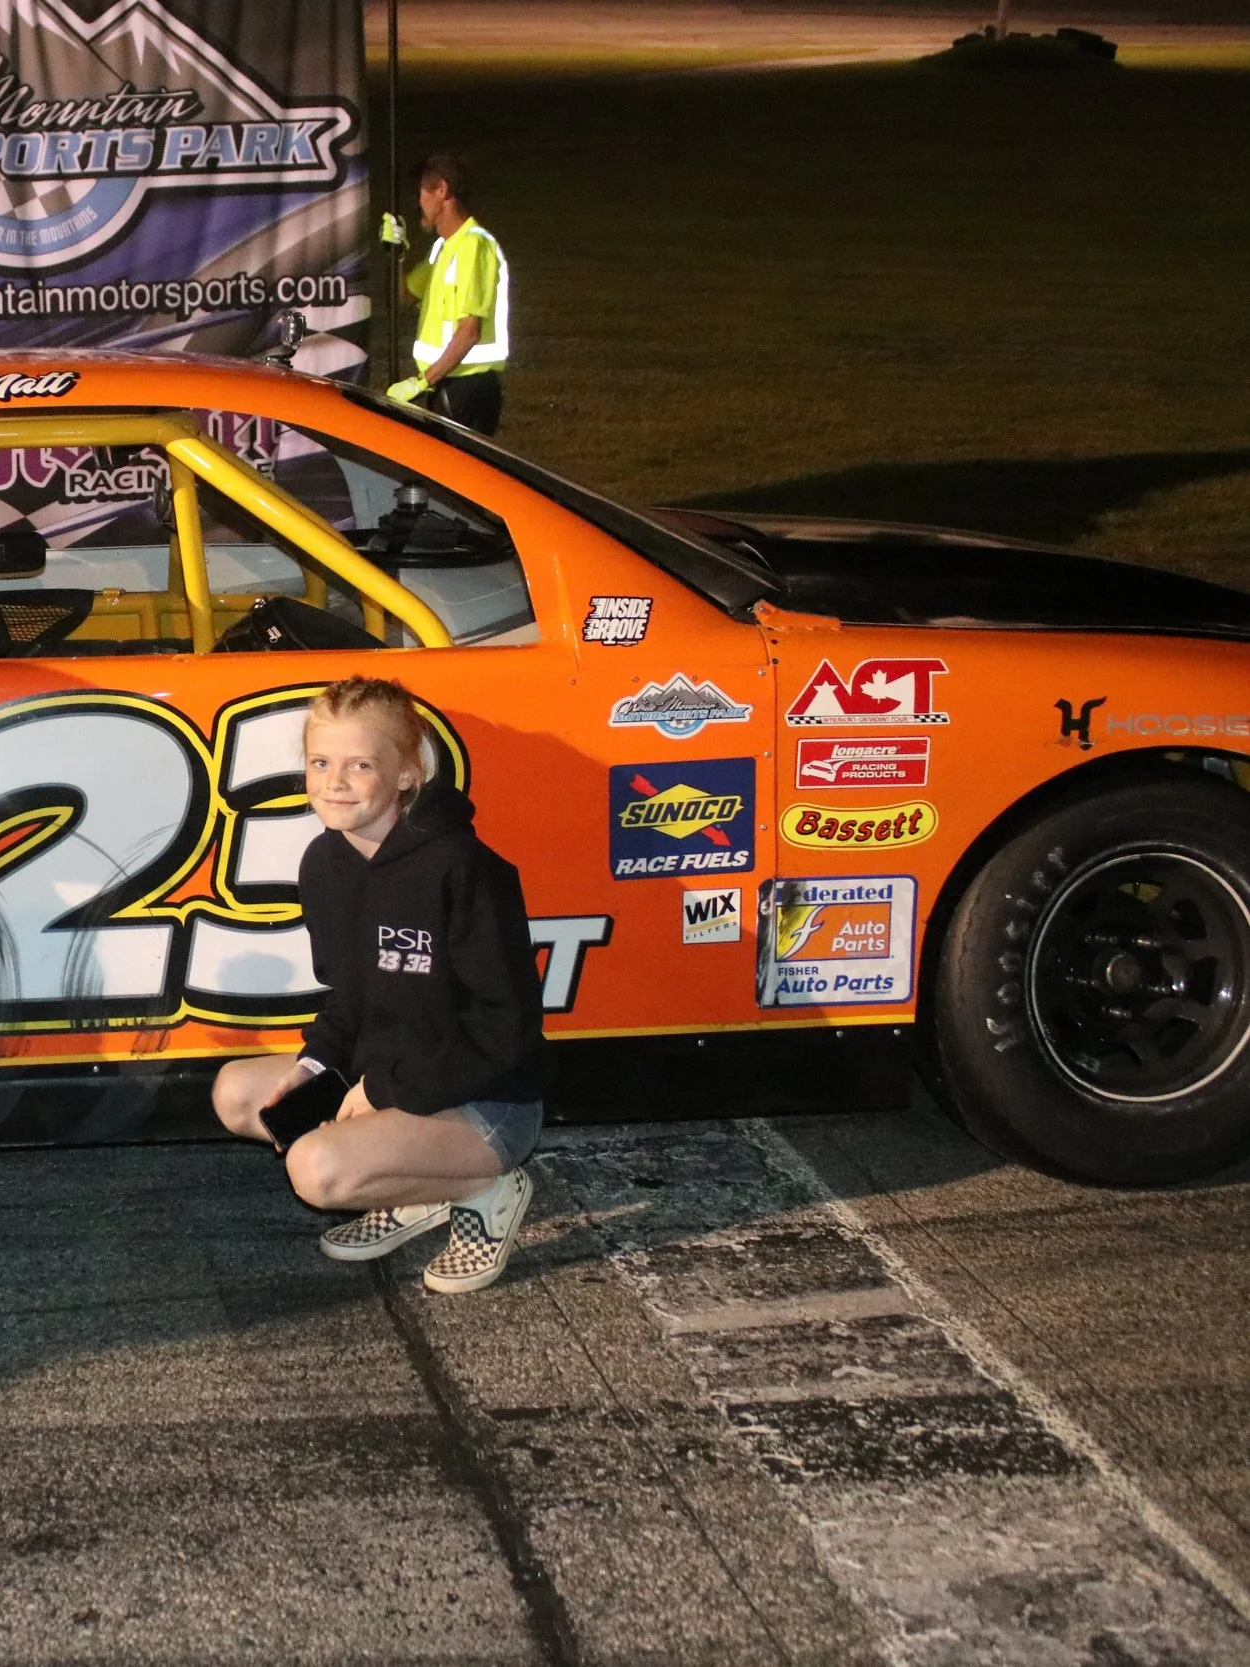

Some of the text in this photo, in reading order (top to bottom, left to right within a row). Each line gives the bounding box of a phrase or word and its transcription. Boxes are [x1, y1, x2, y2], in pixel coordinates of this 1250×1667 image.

[162, 120, 320, 168] PARK
[5, 229, 17, 245] IN
[20, 230, 38, 246] THE
[39, 205, 99, 243] MOUNTAINS
[69, 465, 172, 497] RACIN
[709, 707, 750, 719] PARK
[841, 771, 906, 779] PRODUCTS
[852, 763, 897, 772] RACING
[624, 797, 738, 825] SUNOCO
[795, 807, 923, 842] Bassett
[615, 850, 749, 875] RACE FUELS
[684, 891, 738, 925] WIX
[377, 925, 433, 953] PSR
[684, 920, 738, 941] FILTERS
[838, 920, 886, 936] Auto
[831, 936, 887, 952] Parts
[377, 948, 432, 975] 23 32
[777, 966, 819, 977] FISHER
[774, 974, 895, 995] Auto Parts
